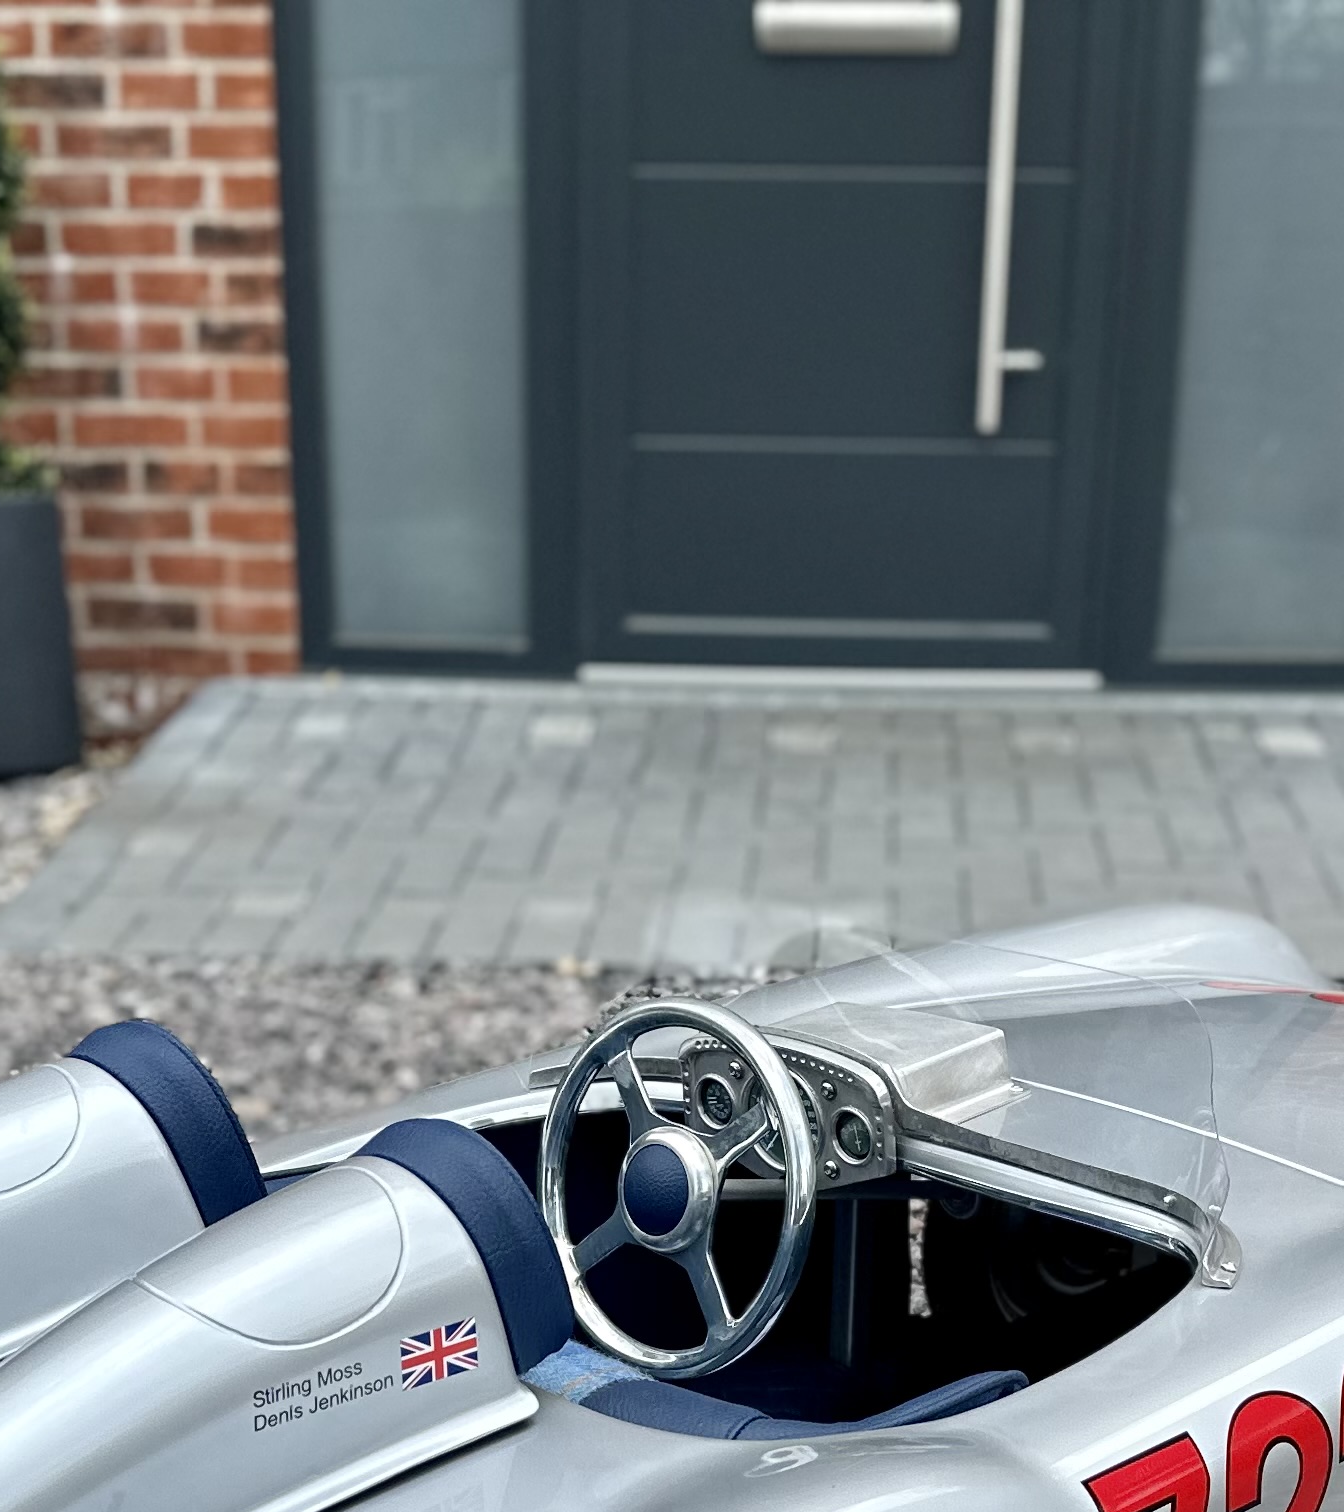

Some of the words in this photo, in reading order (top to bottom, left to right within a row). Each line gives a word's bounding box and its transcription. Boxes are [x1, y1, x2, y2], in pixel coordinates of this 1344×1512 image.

[253, 1379, 311, 1408] Stirling
[317, 1362, 363, 1388] Moss
[254, 1405, 303, 1432] Denis
[309, 1375, 394, 1414] Jenkinson
